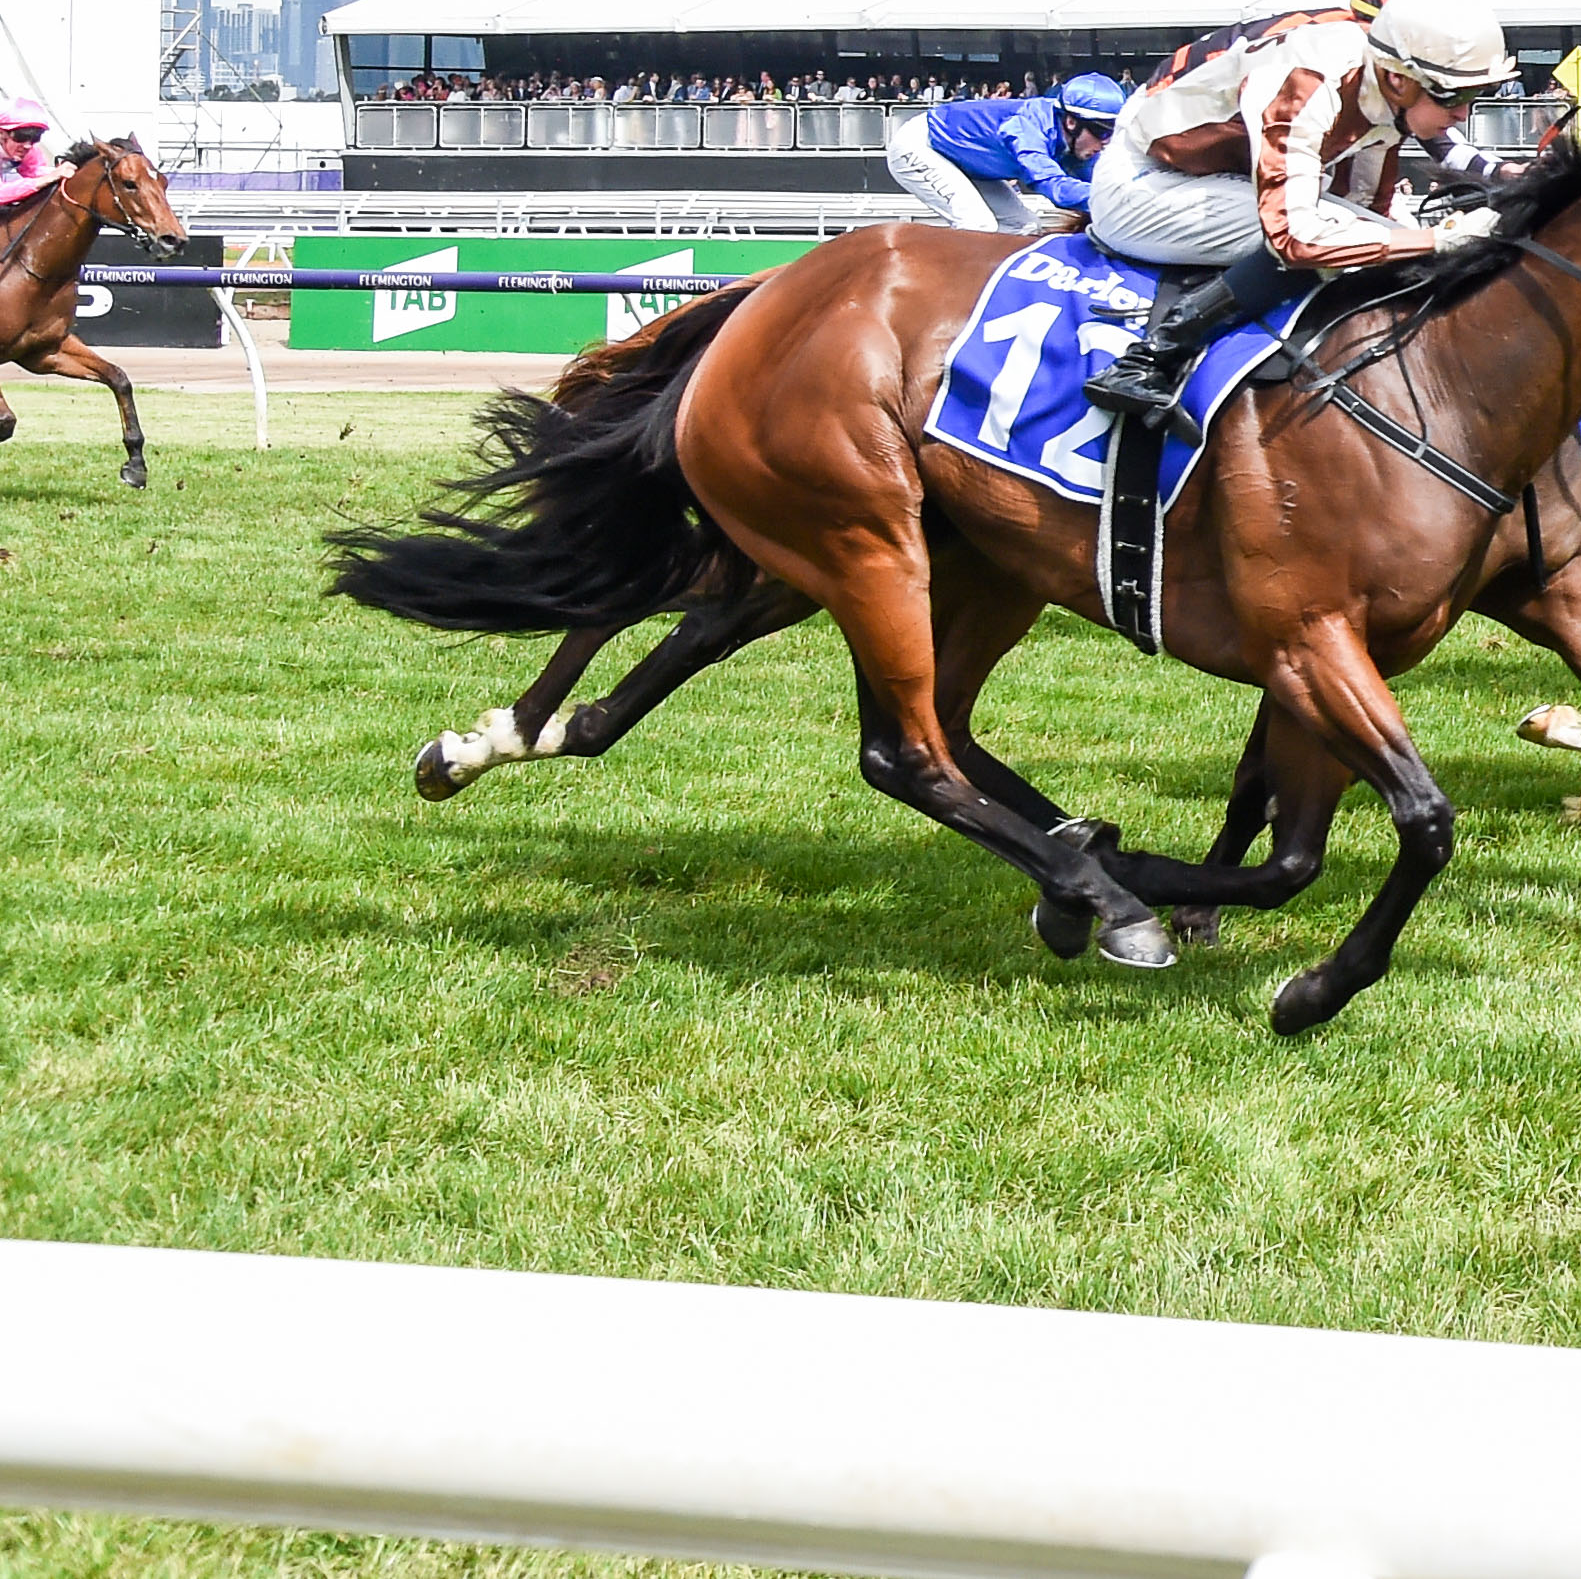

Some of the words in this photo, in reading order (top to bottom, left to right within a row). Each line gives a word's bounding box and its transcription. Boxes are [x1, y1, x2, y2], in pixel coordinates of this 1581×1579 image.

[83, 270, 156, 284] FLEMINGTON
[220, 272, 293, 286] FLEMINGTON
[358, 274, 432, 287] FLEMINGTON
[498, 276, 574, 290] FLEMINGTON
[642, 278, 720, 291] FLEMINGTON
[624, 292, 683, 314] AB
[977, 302, 1143, 490] 12
